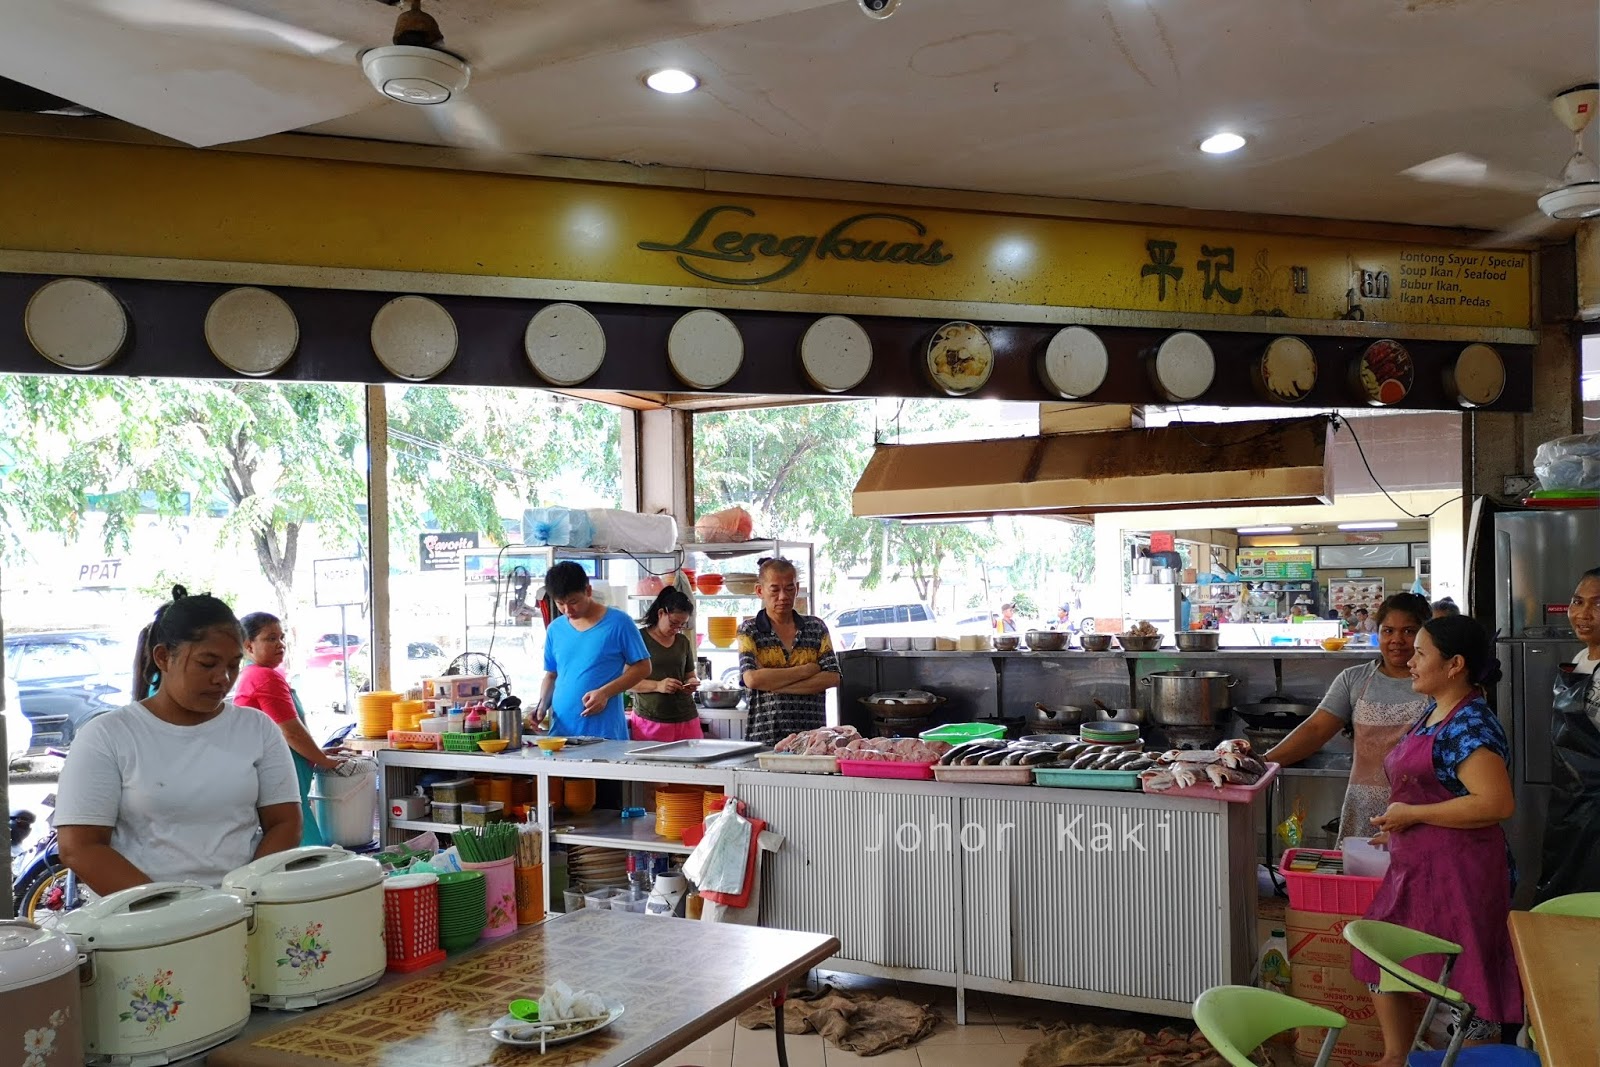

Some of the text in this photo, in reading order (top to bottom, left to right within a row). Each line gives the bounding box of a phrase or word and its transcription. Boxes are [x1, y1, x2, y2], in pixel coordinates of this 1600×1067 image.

[637, 205, 953, 285] Lengkuas
[1400, 251, 1524, 269] Lontong Sayur / Special
[1141, 240, 1243, 304] 平记
[1400, 265, 1507, 280] Soup Ikan / Seafood
[1400, 279, 1462, 292] Bubur Ikan,
[1400, 293, 1491, 307] Ikan Asam Pedas
[79, 563, 122, 580] PPAT
